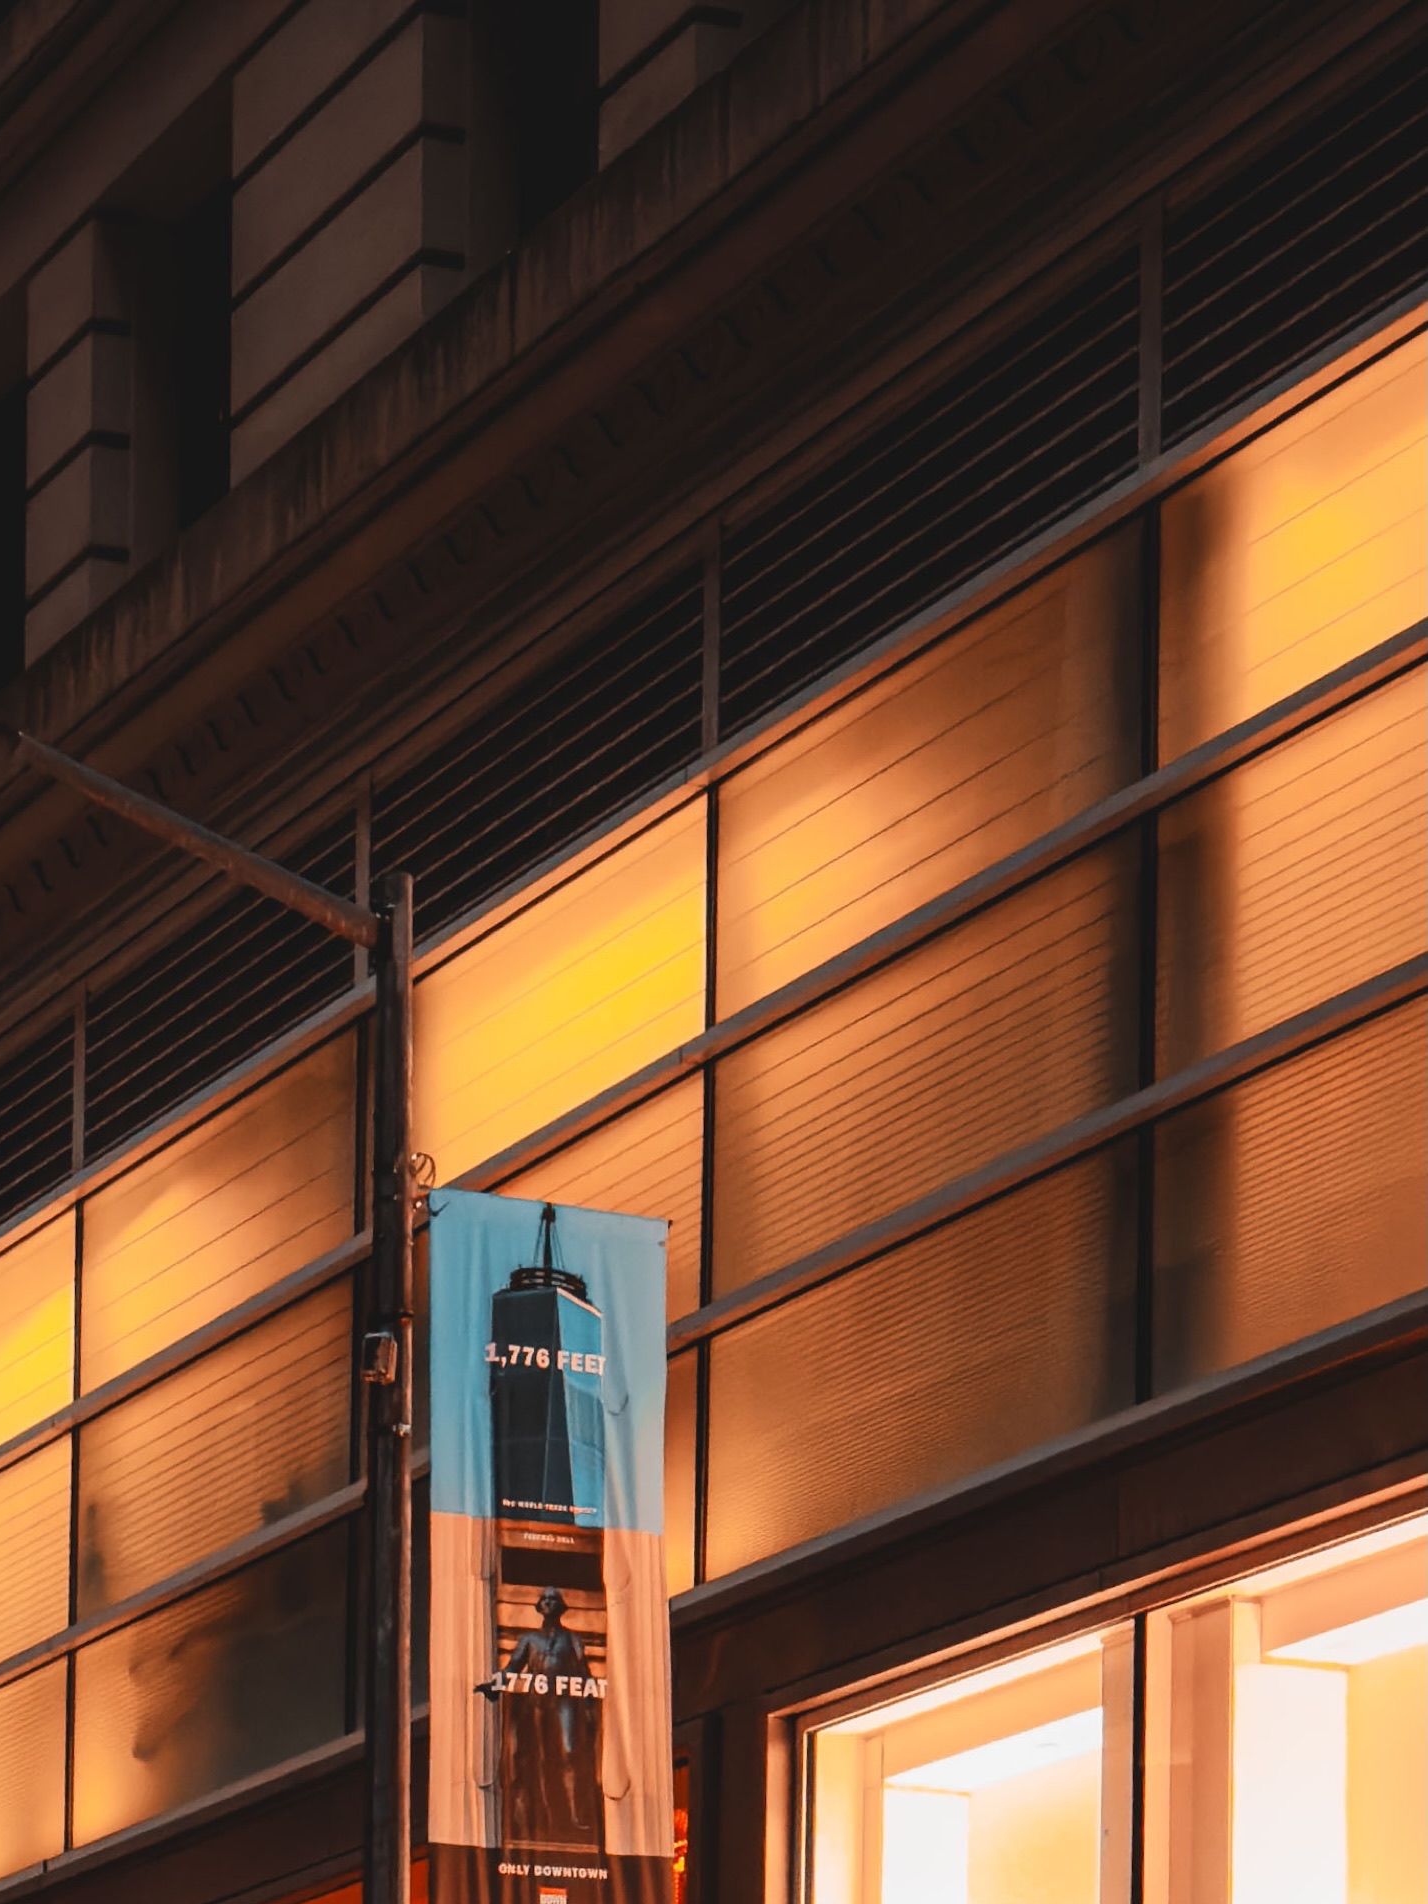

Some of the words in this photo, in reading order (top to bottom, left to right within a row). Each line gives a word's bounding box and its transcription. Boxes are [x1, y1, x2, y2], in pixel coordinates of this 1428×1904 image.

[485, 1342, 550, 1372] 1,776
[556, 1350, 607, 1375] FEET
[491, 1671, 550, 1695] 1776
[554, 1676, 608, 1699] FEAT
[497, 1862, 531, 1876] ONLY
[533, 1864, 608, 1880] DOWNTOWN
